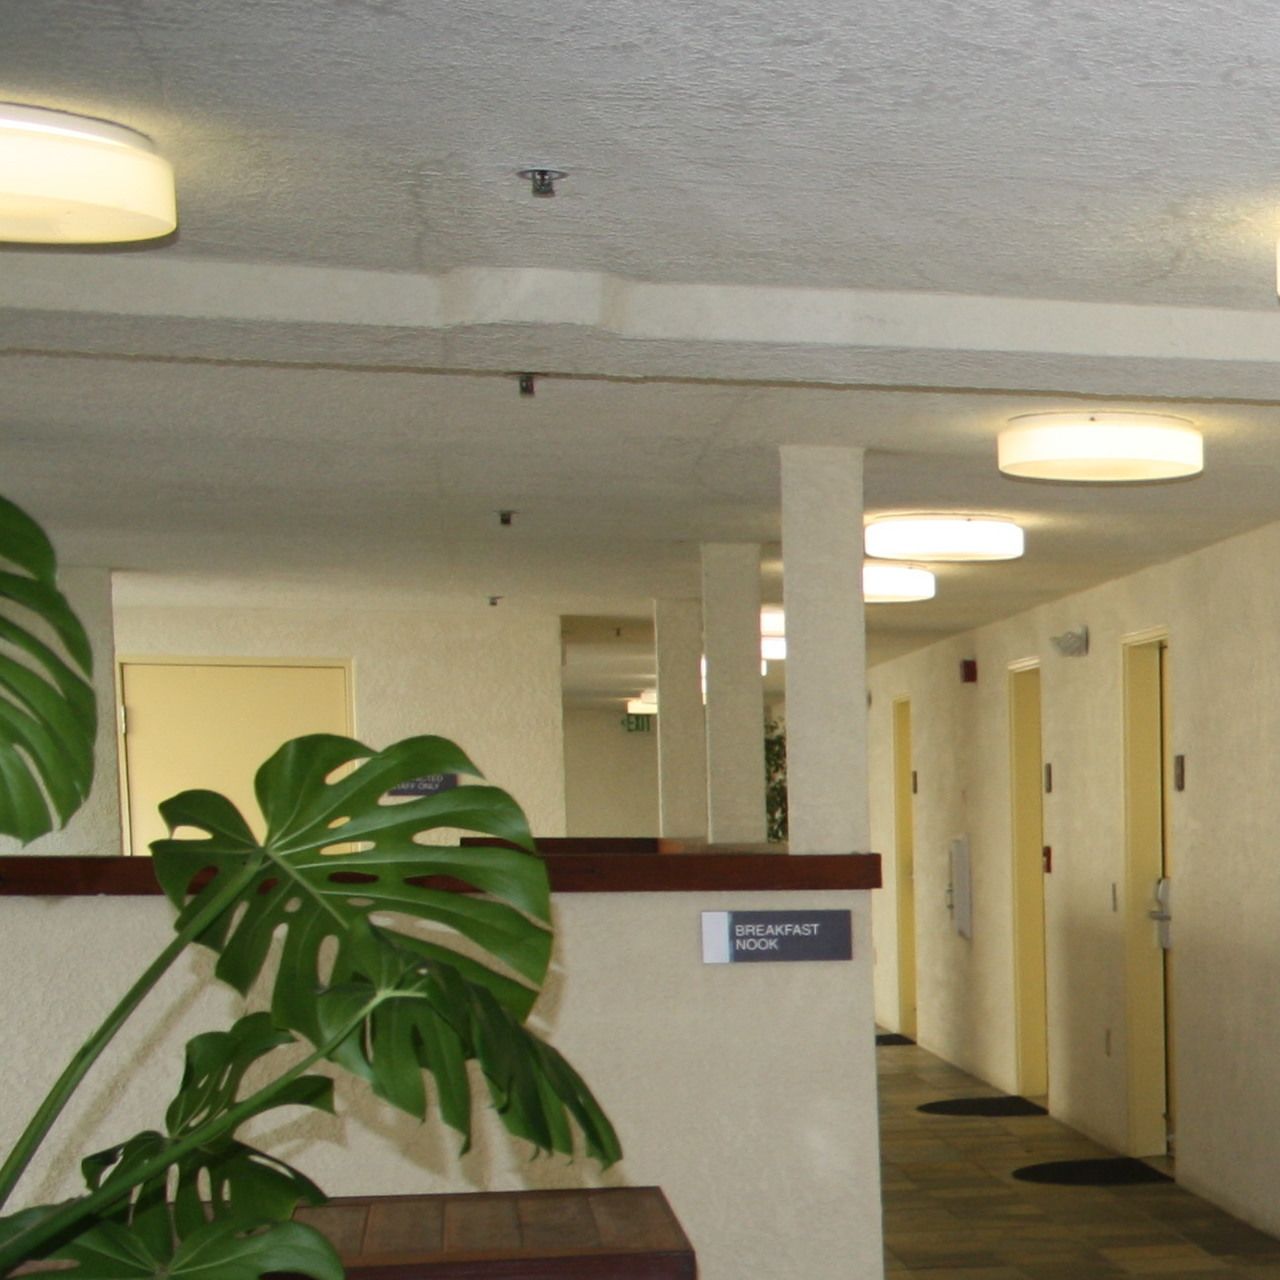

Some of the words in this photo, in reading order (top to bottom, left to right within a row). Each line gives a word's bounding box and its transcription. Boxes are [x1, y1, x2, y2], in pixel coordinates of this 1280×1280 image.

[627, 714, 651, 732] EXIT
[417, 782, 440, 791] ONLY
[735, 923, 820, 937] BREAKFAST
[735, 938, 779, 951] NOOK
